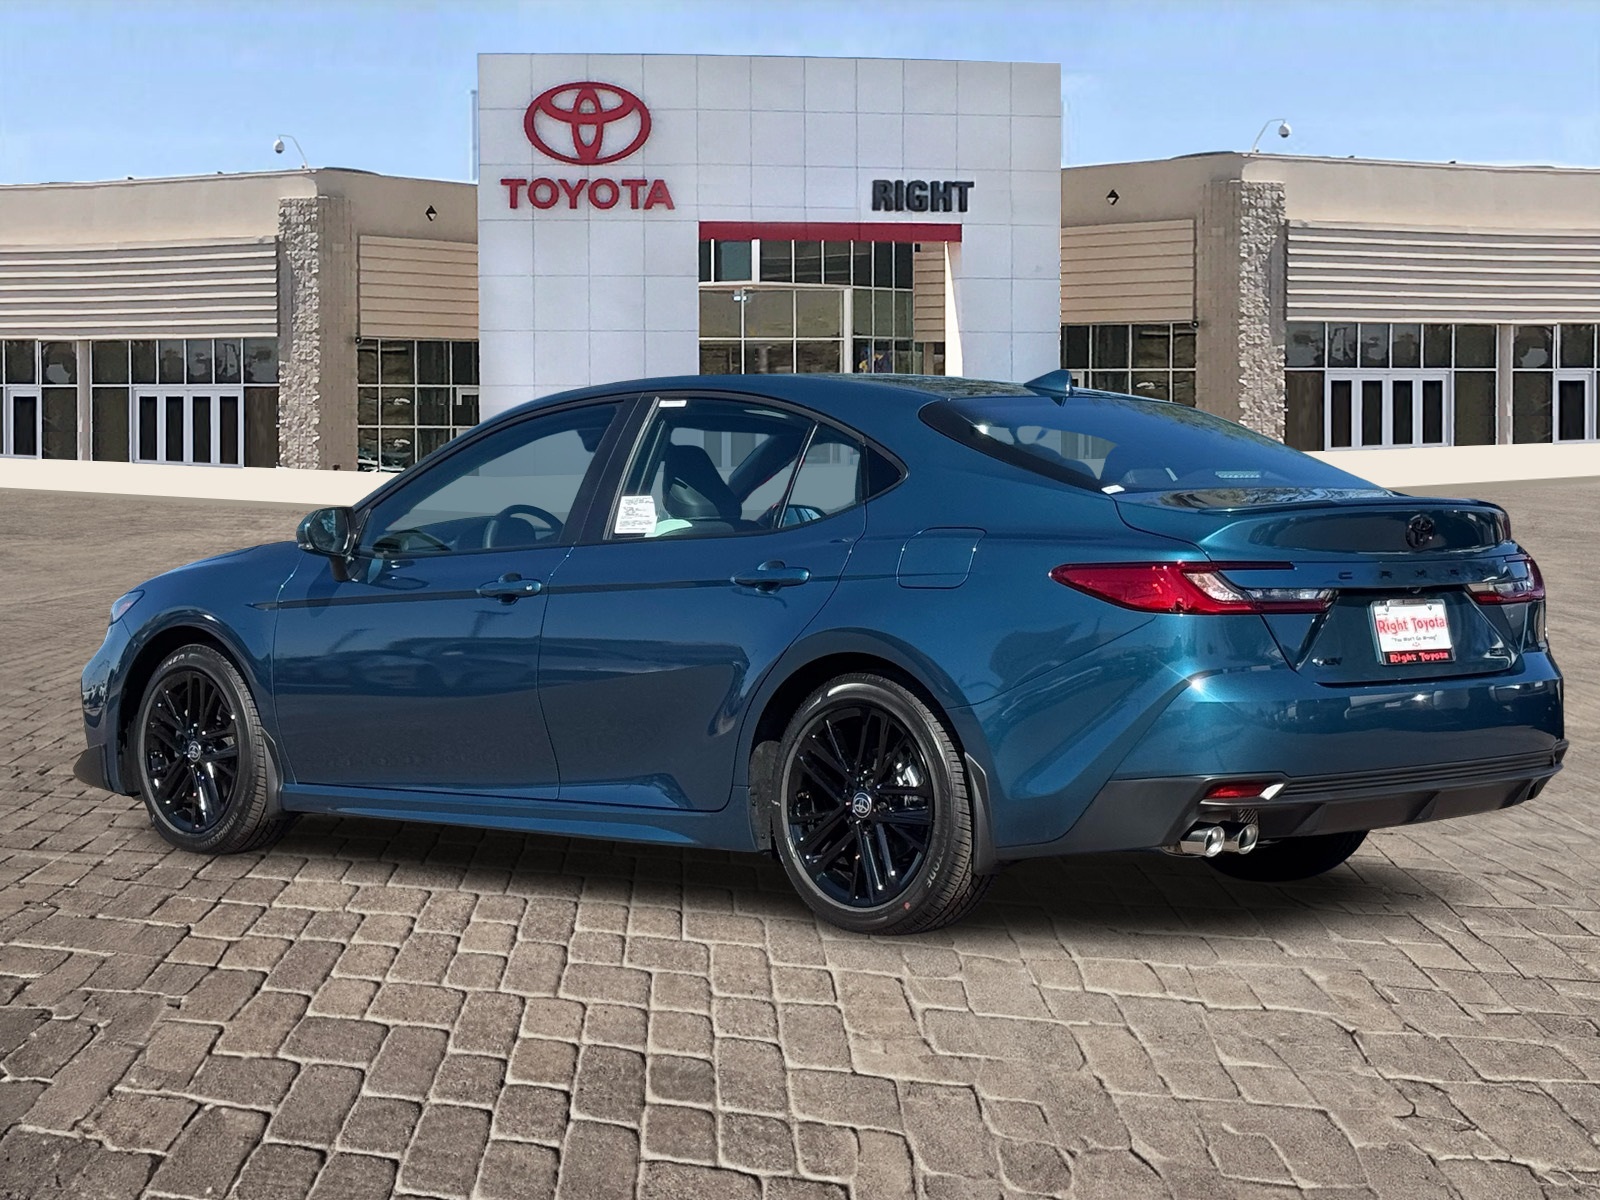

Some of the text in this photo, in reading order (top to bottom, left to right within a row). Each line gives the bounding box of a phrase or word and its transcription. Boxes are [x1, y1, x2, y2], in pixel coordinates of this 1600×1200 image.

[500, 177, 675, 210] TOYOTA
[872, 179, 975, 212] RIGHT
[1376, 617, 1446, 635] Right Toyota
[1389, 652, 1449, 663] Right Toyota
